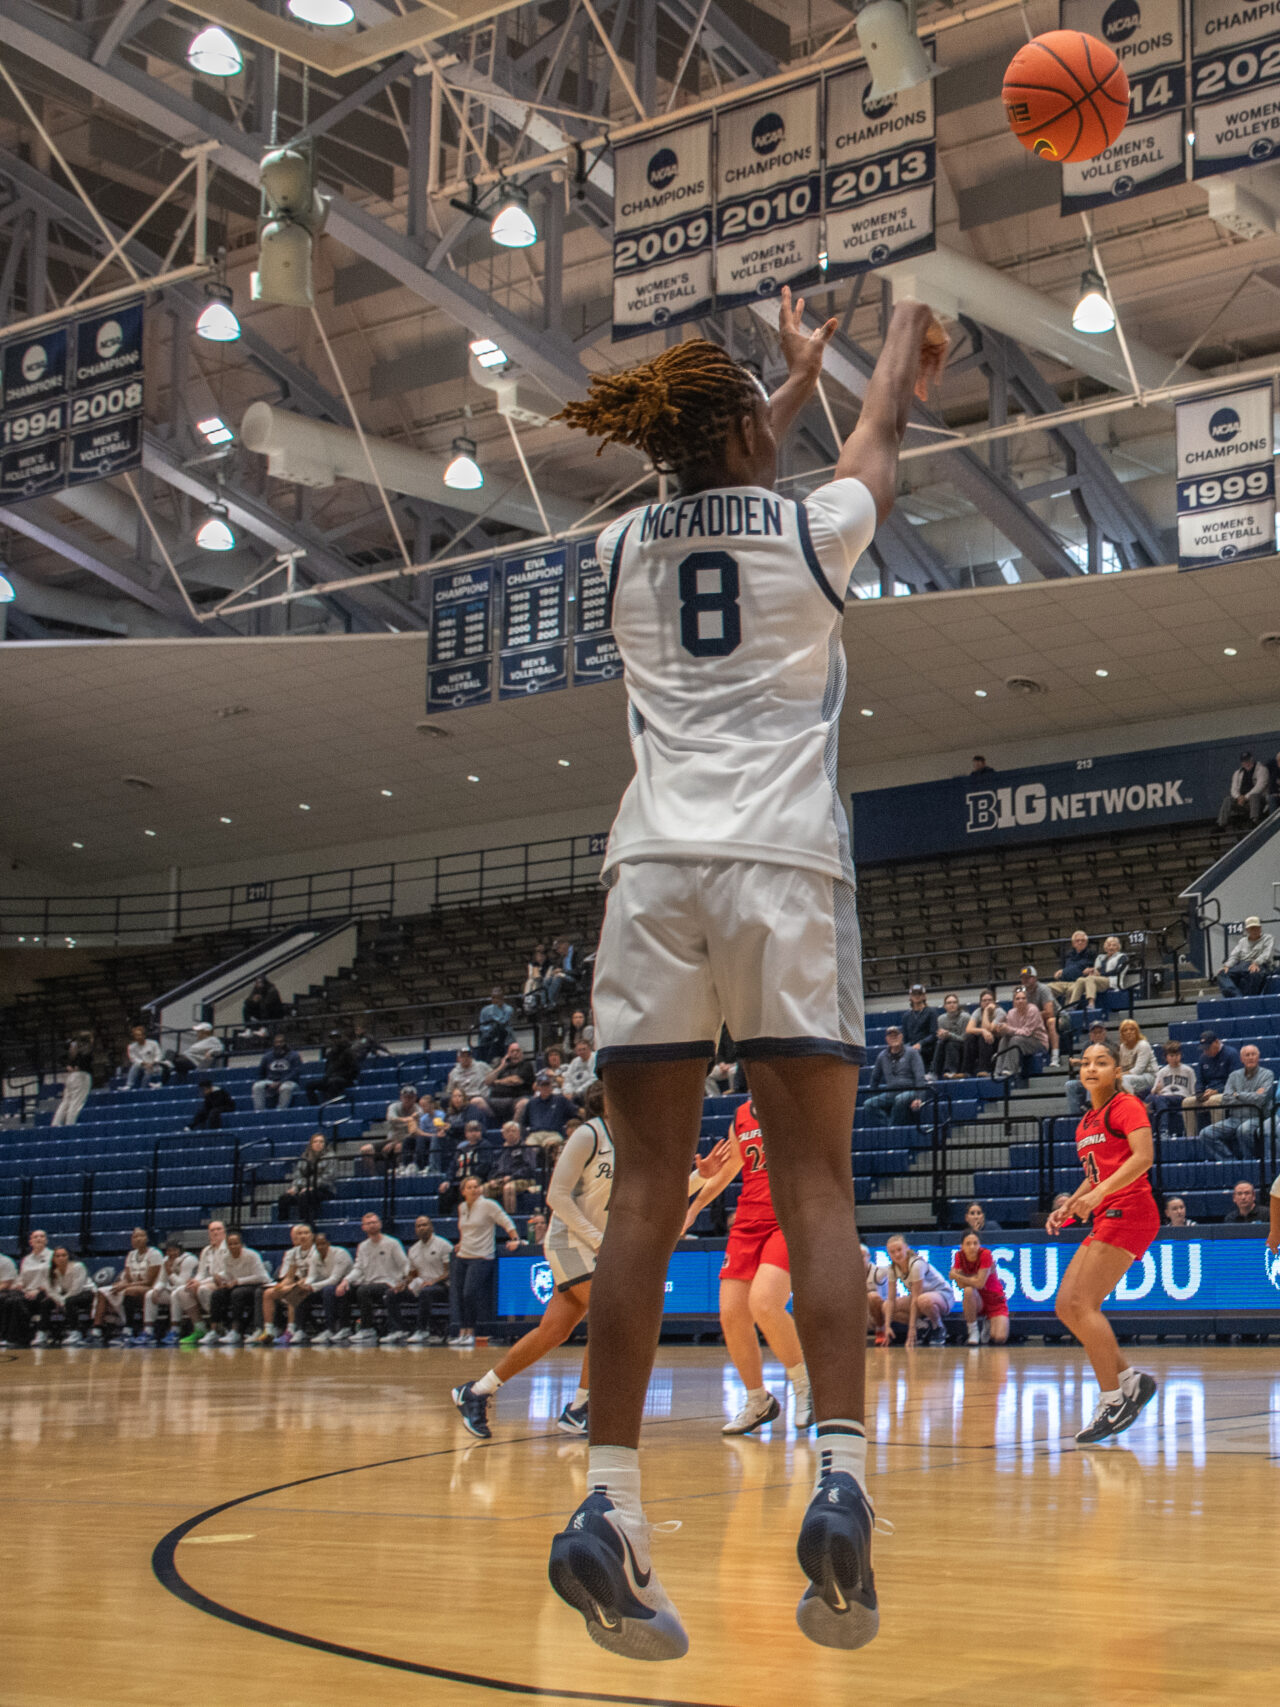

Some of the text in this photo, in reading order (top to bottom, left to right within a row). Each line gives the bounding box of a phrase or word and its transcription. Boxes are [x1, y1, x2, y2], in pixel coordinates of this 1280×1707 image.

[1106, 16, 1141, 37] NCAA
[1116, 32, 1173, 60] PIONS
[1129, 75, 1173, 115] 14
[754, 125, 785, 147] NCAA
[836, 111, 927, 148] CHAMPIONS
[650, 163, 678, 182] NCAA
[725, 146, 812, 184] CHAMPIONS
[831, 152, 928, 203] 2013
[1081, 150, 1165, 181] VOLLEYBALL
[620, 180, 705, 217] CHAMPIONS
[721, 186, 812, 237] 2010
[851, 207, 908, 234] WOMEN'S
[615, 218, 709, 269] 2009
[843, 219, 917, 249] VOLLEYBALL
[741, 240, 796, 265] WOMEN'S
[731, 253, 803, 281] VOLLEYBALL
[636, 273, 689, 296] WOMEN'S
[628, 286, 697, 312] VOLLEYBALL
[78, 350, 139, 379] CHAMPIONS
[7, 375, 62, 400] CHAMPIONS
[72, 383, 142, 424] 2008
[4, 408, 61, 443] 1994
[1212, 420, 1242, 436] NCAA
[80, 441, 131, 462] VOLLEYBALL
[93, 432, 120, 446] MEN'S
[1185, 437, 1267, 464] CHAMPIONS
[5, 460, 56, 481] VOLLEYBALL
[1183, 471, 1268, 508] 1999
[1194, 525, 1263, 546] VOLLEYBALL
[1202, 516, 1255, 533] WOMEN'S
[507, 565, 563, 585] CHAMPIONS
[524, 556, 546, 571] EIVA
[435, 582, 489, 602] CHAMPIONS
[453, 574, 473, 588] EIVA
[678, 551, 741, 658] 8
[510, 665, 557, 680] VOLLEYBALL
[521, 657, 546, 668] MEN'S
[437, 679, 482, 694] VOLLEYBALL
[448, 671, 472, 683] MEN'S
[1076, 759, 1093, 770] 213
[966, 779, 1184, 833] B1G NETWORK
[1129, 932, 1144, 944] 113
[1227, 923, 1243, 933] 114
